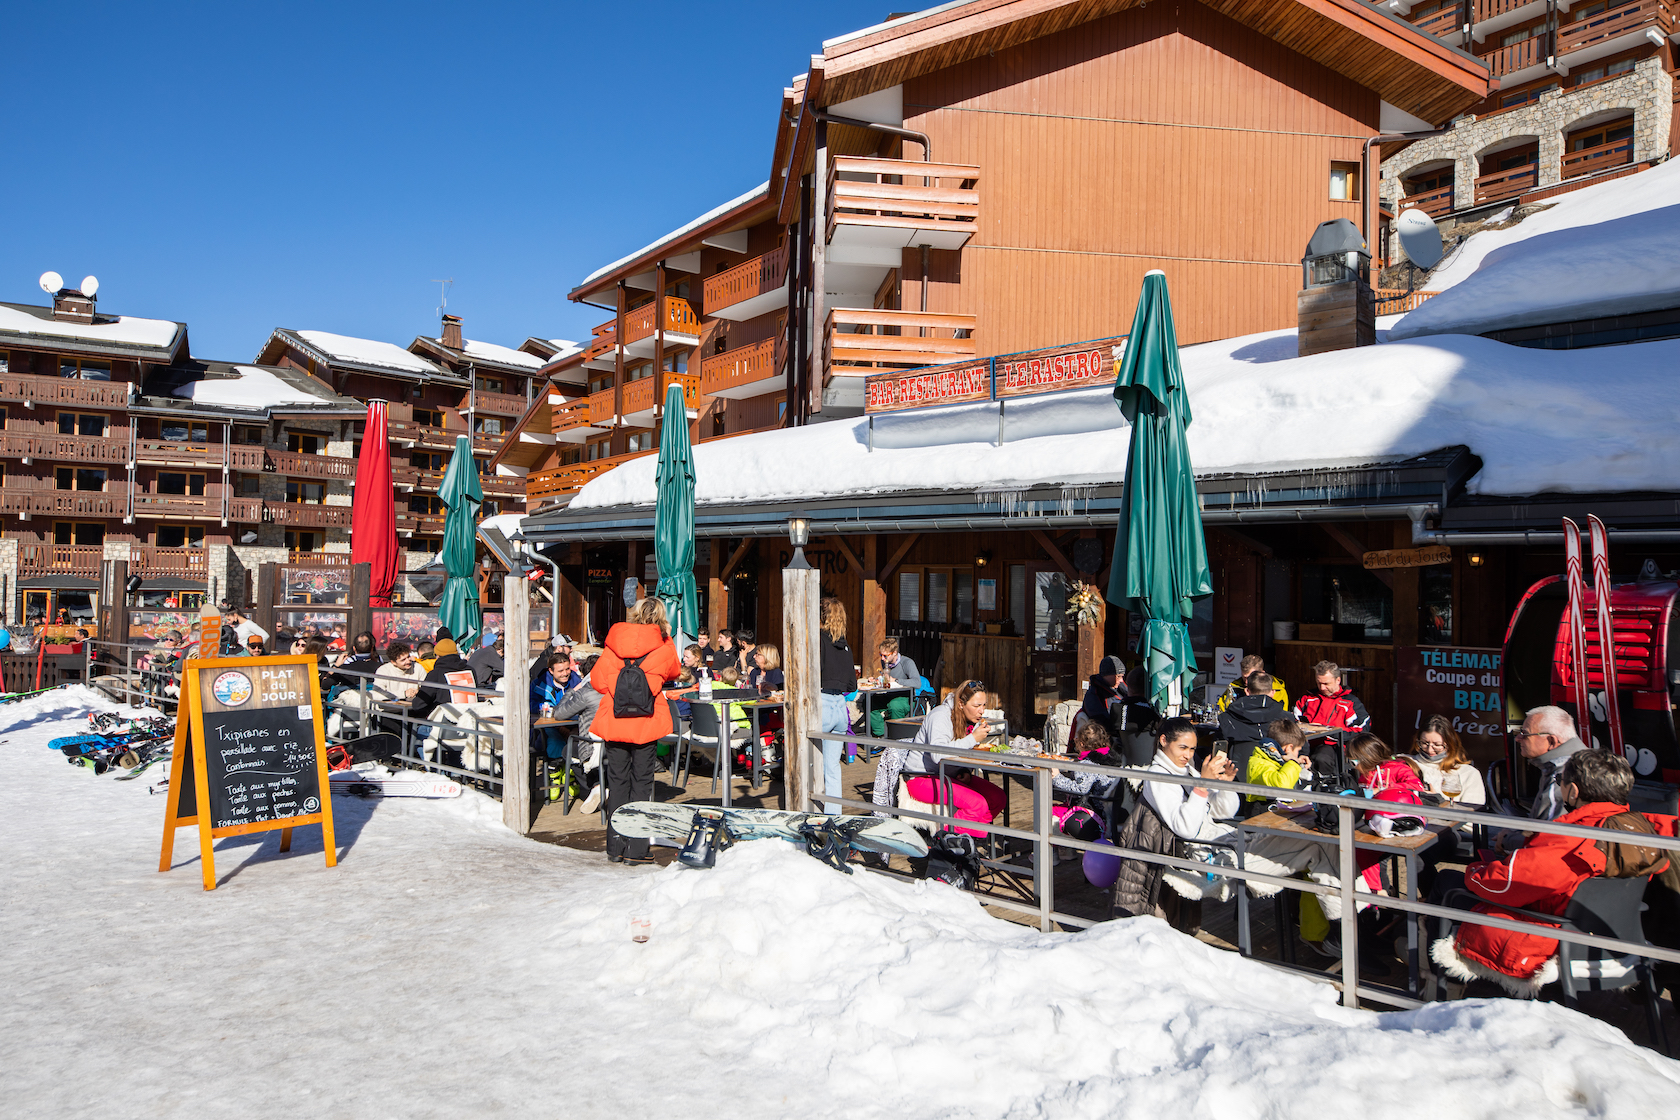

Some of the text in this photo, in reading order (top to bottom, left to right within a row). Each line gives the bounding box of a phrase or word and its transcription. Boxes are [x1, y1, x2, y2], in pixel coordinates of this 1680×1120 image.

[1004, 350, 1103, 389] LE RASTRO
[1366, 552, 1393, 567] Plat
[1396, 551, 1412, 565] du
[587, 568, 613, 577] PIZZA
[200, 616, 221, 659] ROS
[262, 669, 294, 680] PLAT
[1426, 668, 1501, 688] Coupe du
[270, 681, 287, 690] du
[262, 691, 297, 702] JOUR
[277, 728, 291, 737] en
[224, 782, 248, 795] Tarte
[250, 783, 265, 791] aux
[228, 792, 249, 804] Tarte
[253, 792, 267, 800] aux
[230, 804, 252, 816] Tarte
